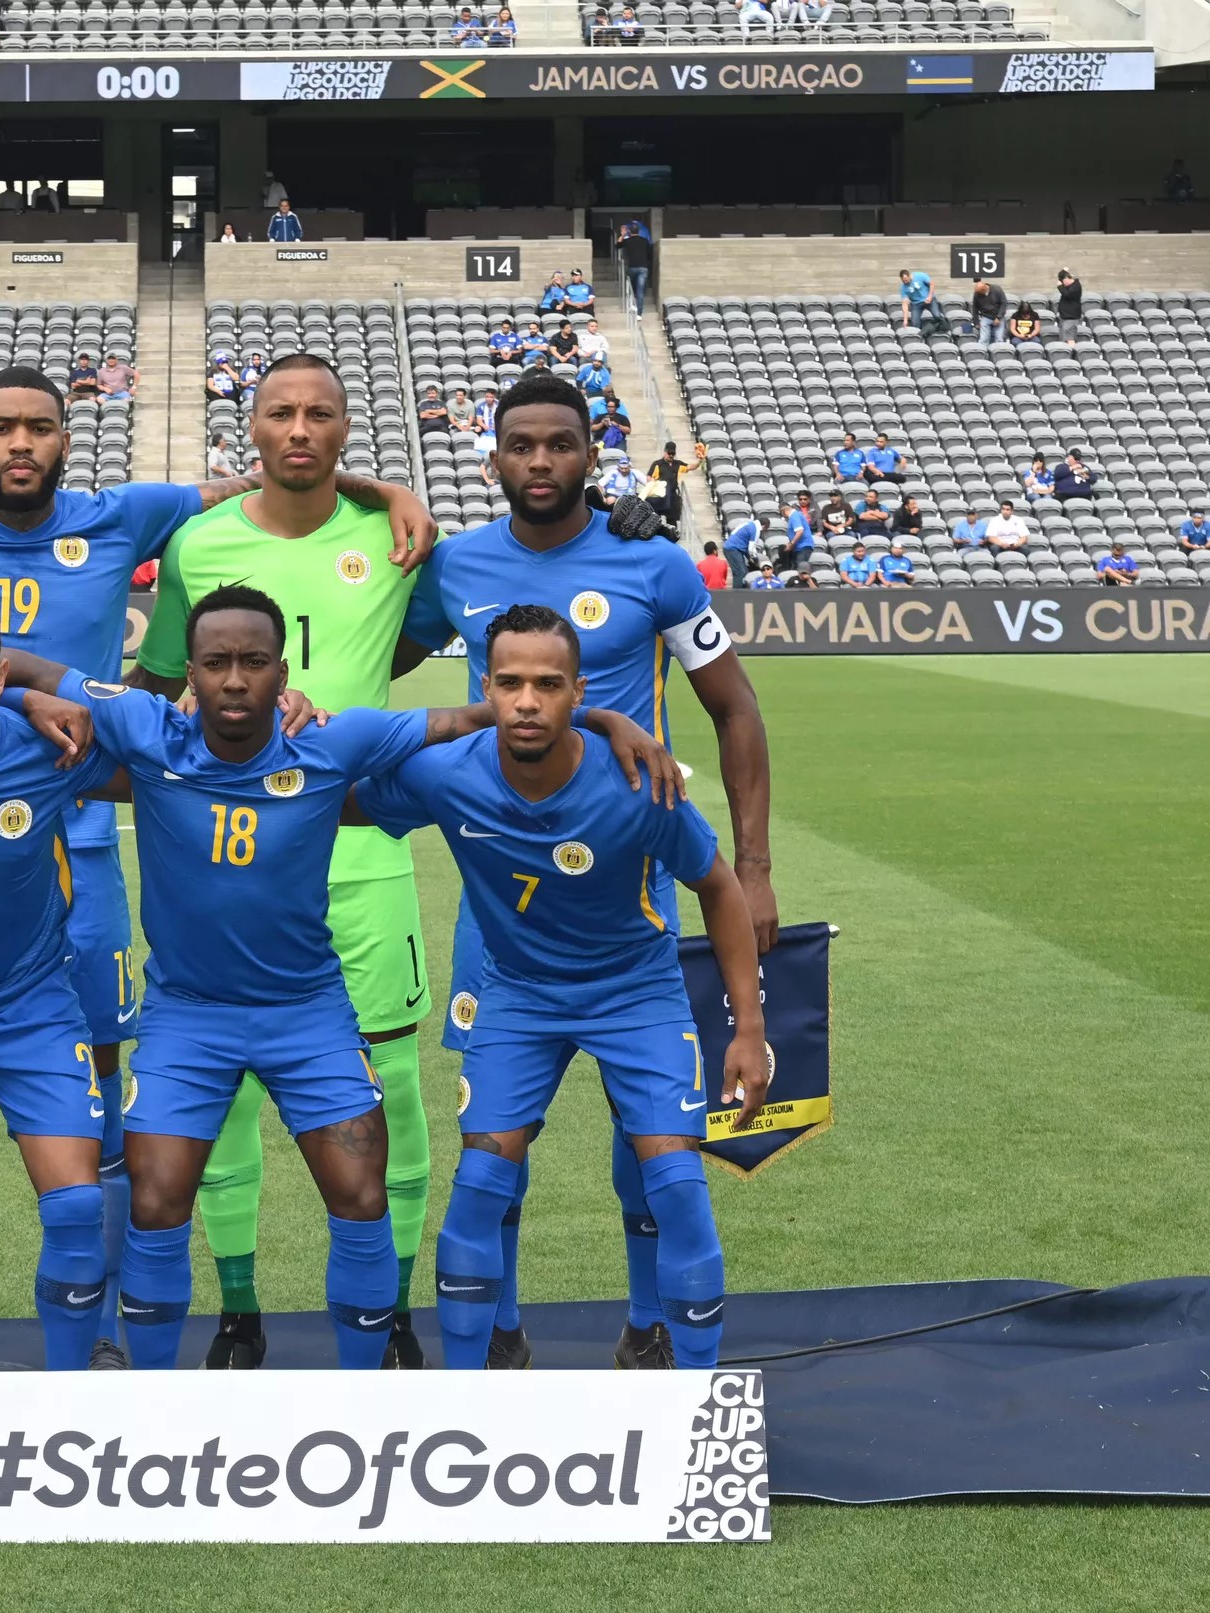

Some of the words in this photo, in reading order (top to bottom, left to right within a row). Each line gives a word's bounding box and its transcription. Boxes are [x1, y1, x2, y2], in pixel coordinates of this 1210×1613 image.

[96, 65, 180, 99] 0:00
[529, 65, 659, 91] JAMAICA
[670, 65, 708, 91] VS
[718, 63, 864, 95] CURAÇAO
[14, 254, 54, 262] FIGUEROA
[55, 254, 62, 262] B
[278, 252, 317, 260] FIGUEROA
[318, 252, 327, 260] C
[473, 256, 513, 277] 114
[958, 252, 998, 273] 115
[693, 615, 721, 651] C
[730, 601, 973, 644] JAMAICA
[994, 600, 1064, 643] VS
[296, 615, 310, 670] 1
[210, 803, 258, 866] 18
[512, 872, 540, 913] 7
[406, 934, 421, 989] 1
[75, 1042, 102, 1098] 2
[682, 1032, 701, 1091] 7
[709, 1114, 723, 1125] BANC
[724, 1112, 732, 1122] OF
[767, 1103, 794, 1116] STADIUM
[765, 1118, 774, 1128] CA
[710, 1374, 764, 1408] CU
